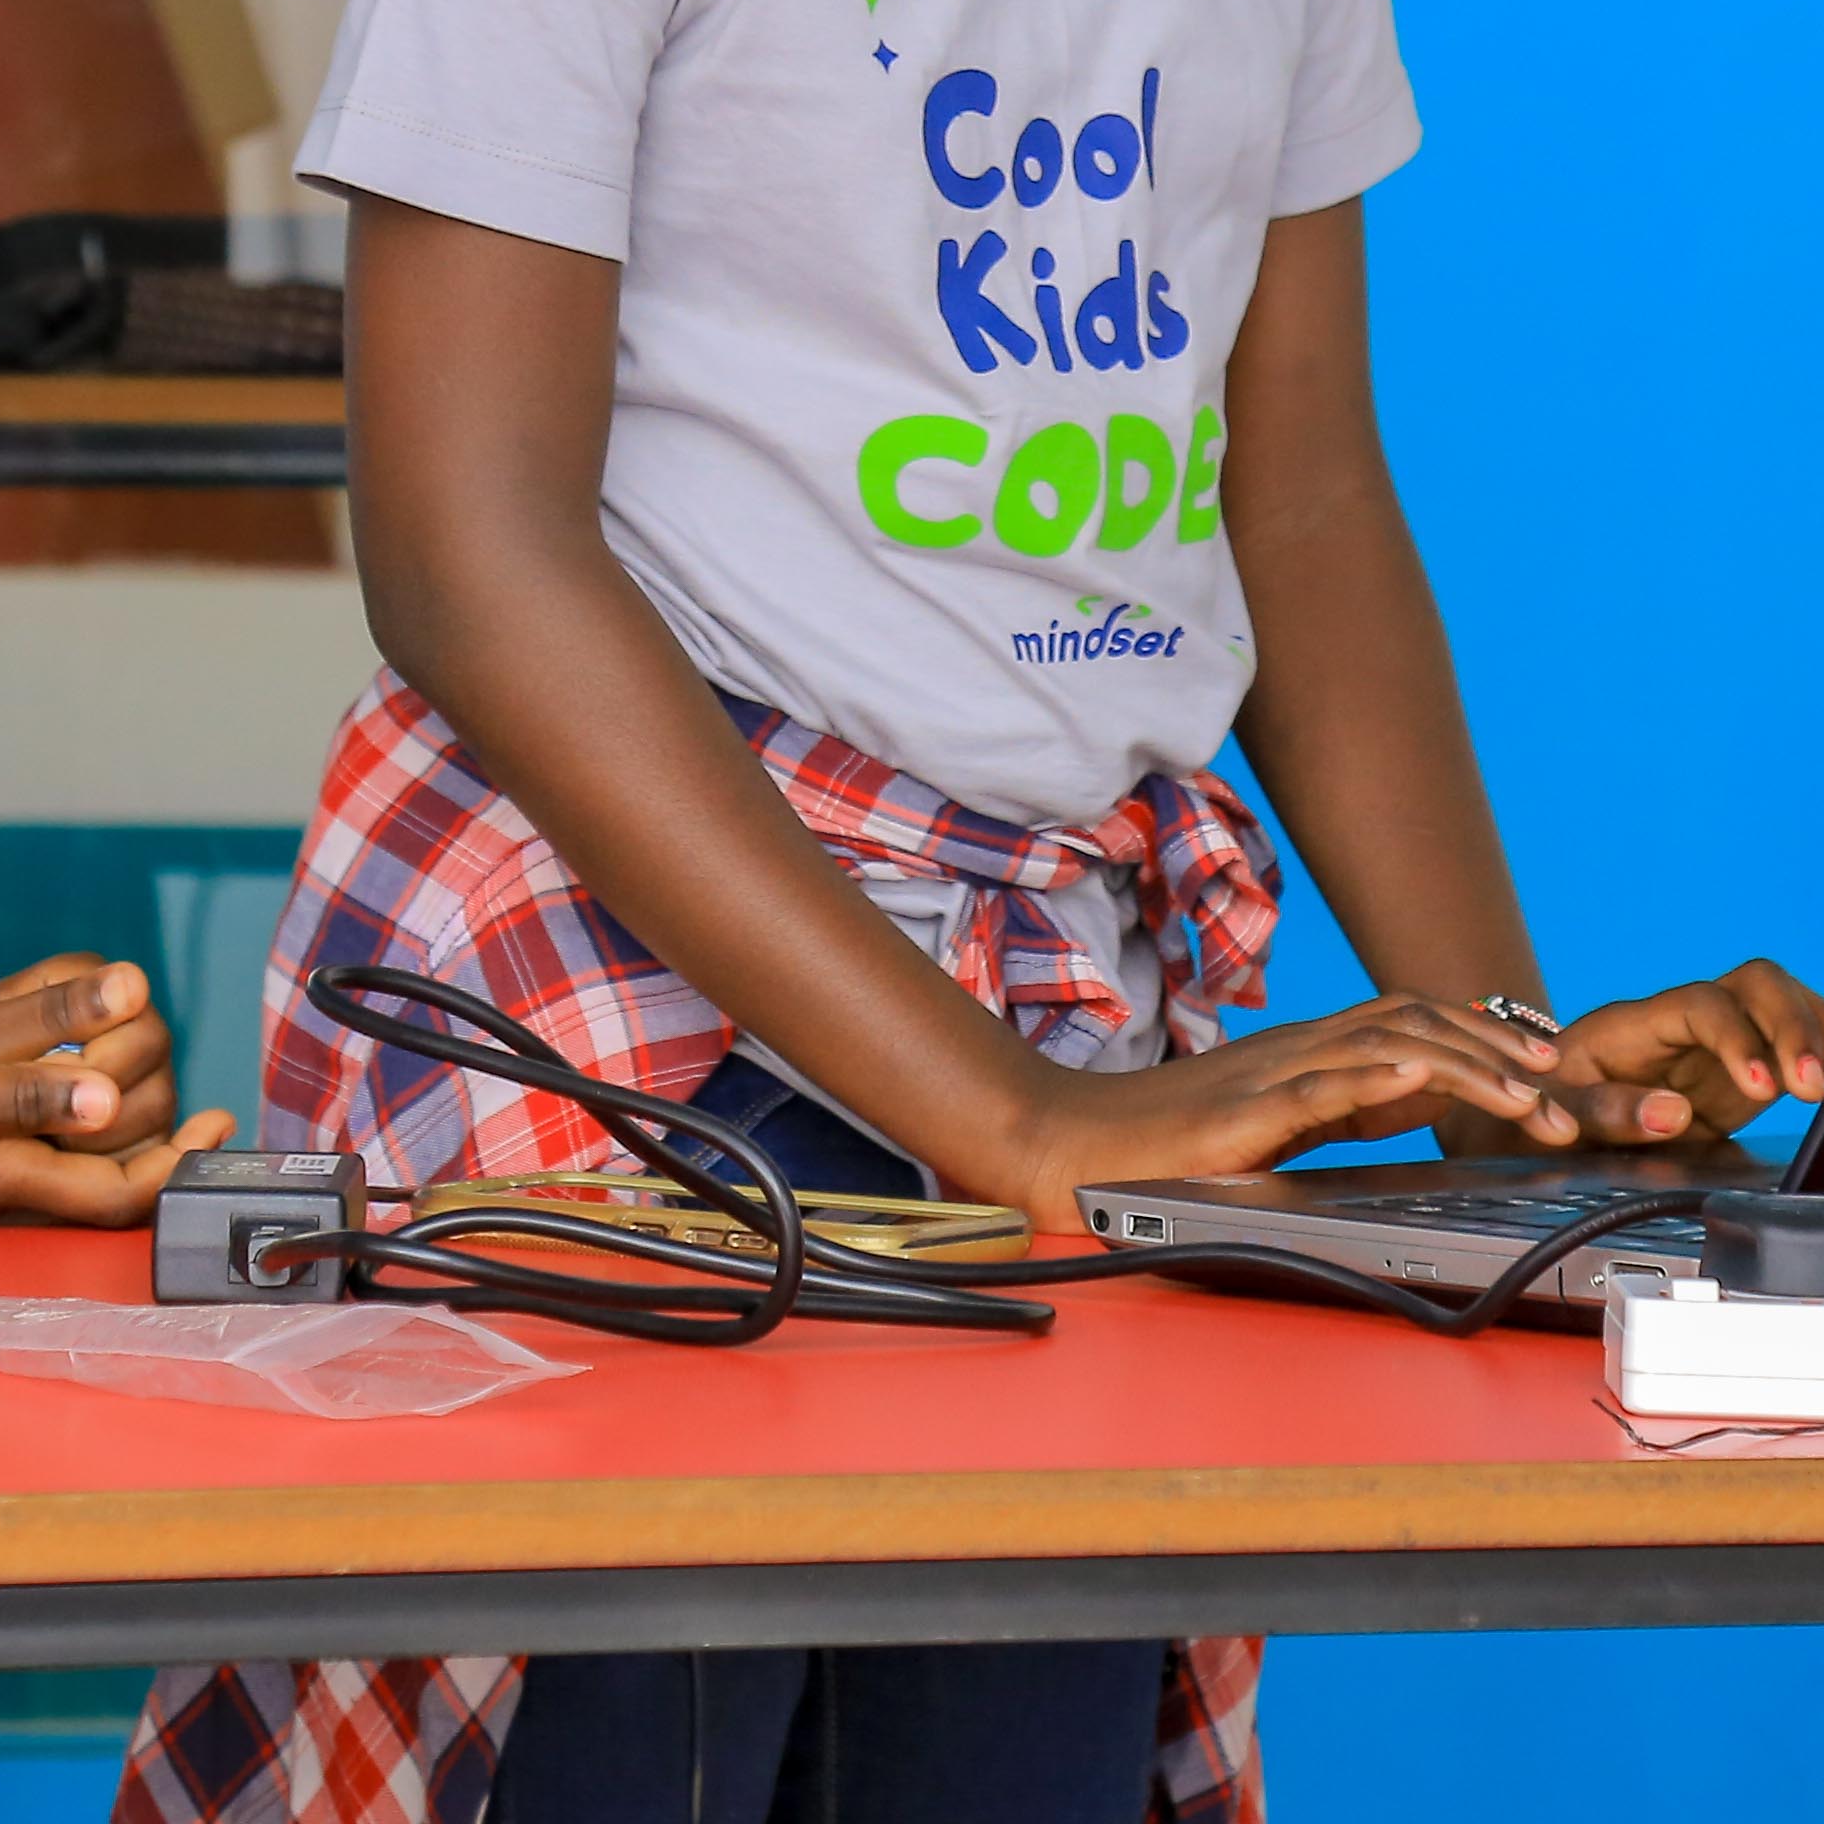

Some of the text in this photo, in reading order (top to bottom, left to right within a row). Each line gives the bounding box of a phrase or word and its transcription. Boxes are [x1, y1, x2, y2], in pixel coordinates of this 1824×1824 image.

[923, 68, 1160, 209] Cool
[937, 229, 1190, 374] Kids
[857, 404, 1223, 558] CODE
[1011, 603, 1185, 664] mindset
